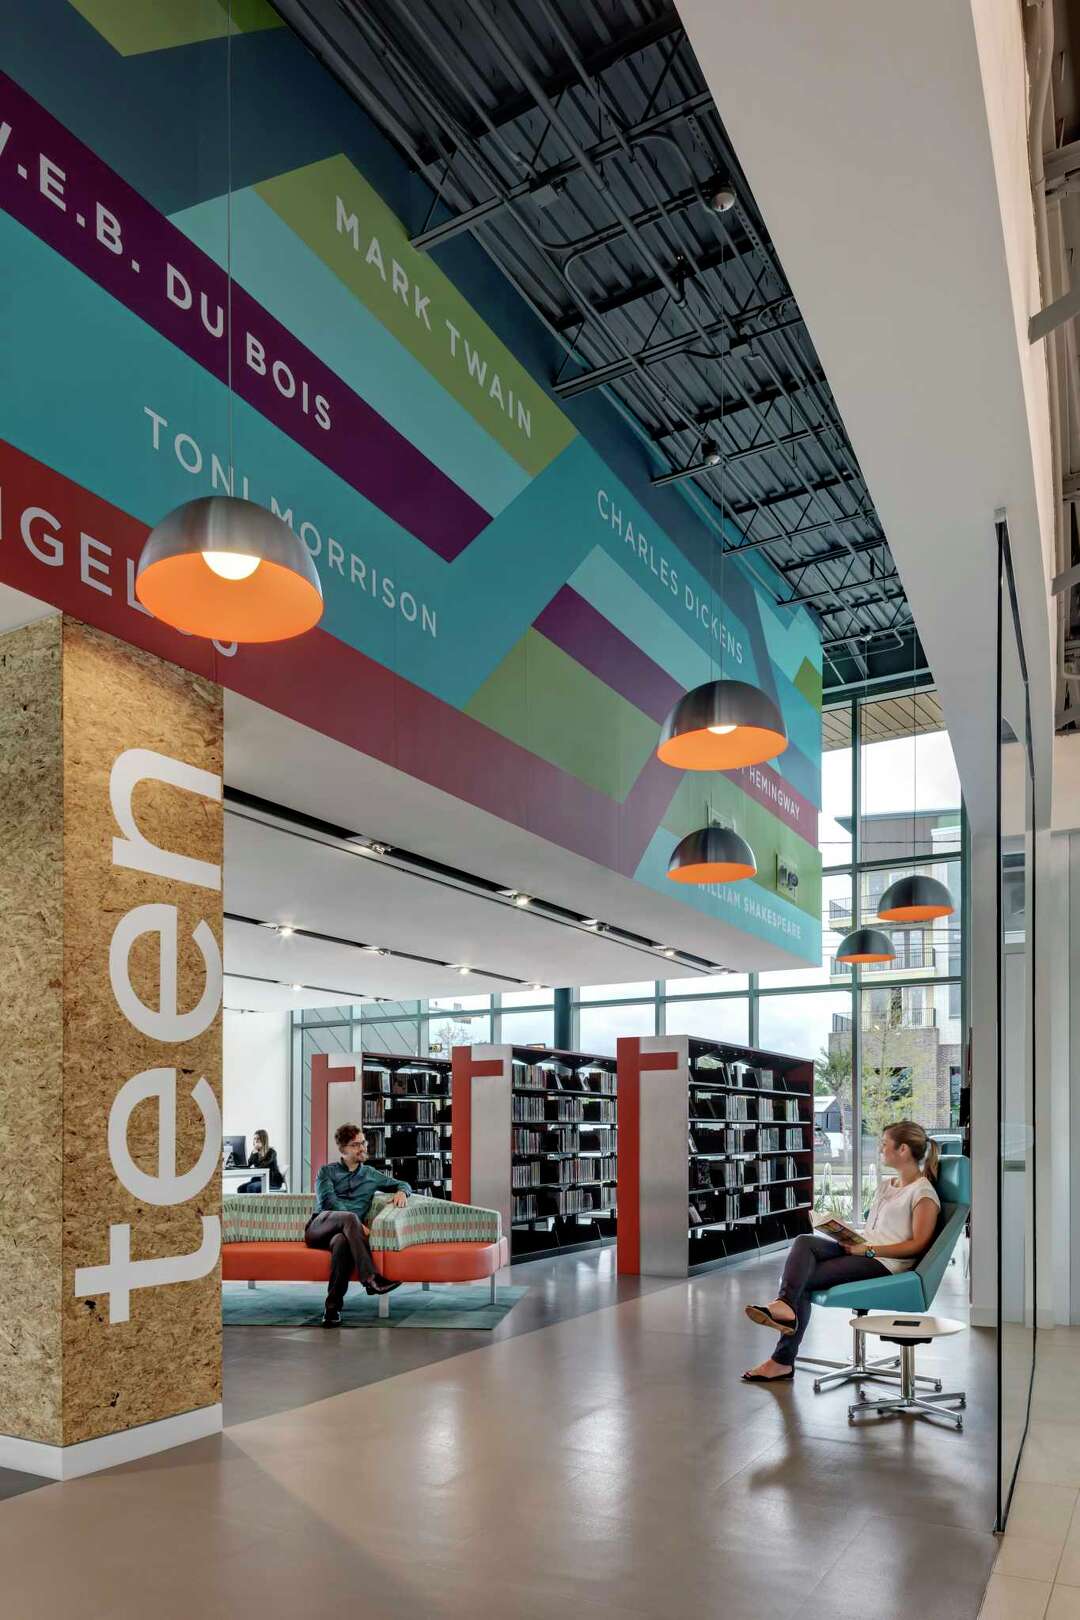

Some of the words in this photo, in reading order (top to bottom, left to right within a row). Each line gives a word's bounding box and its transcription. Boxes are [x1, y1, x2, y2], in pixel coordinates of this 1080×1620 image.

[0, 122, 140, 273] .E.B.
[166, 262, 224, 338] DU
[246, 331, 331, 430] BOIS
[336, 195, 432, 332] MARK
[446, 319, 531, 439] TWAIN
[144, 406, 248, 500] TONI
[271, 496, 436, 637] MORRISON
[597, 489, 679, 595] CHARLES
[685, 584, 743, 664] DICKENS
[749, 762, 800, 821] HEMINGWAY
[743, 897, 801, 940] SHAKESPEARE
[75, 747, 224, 1324] teen
